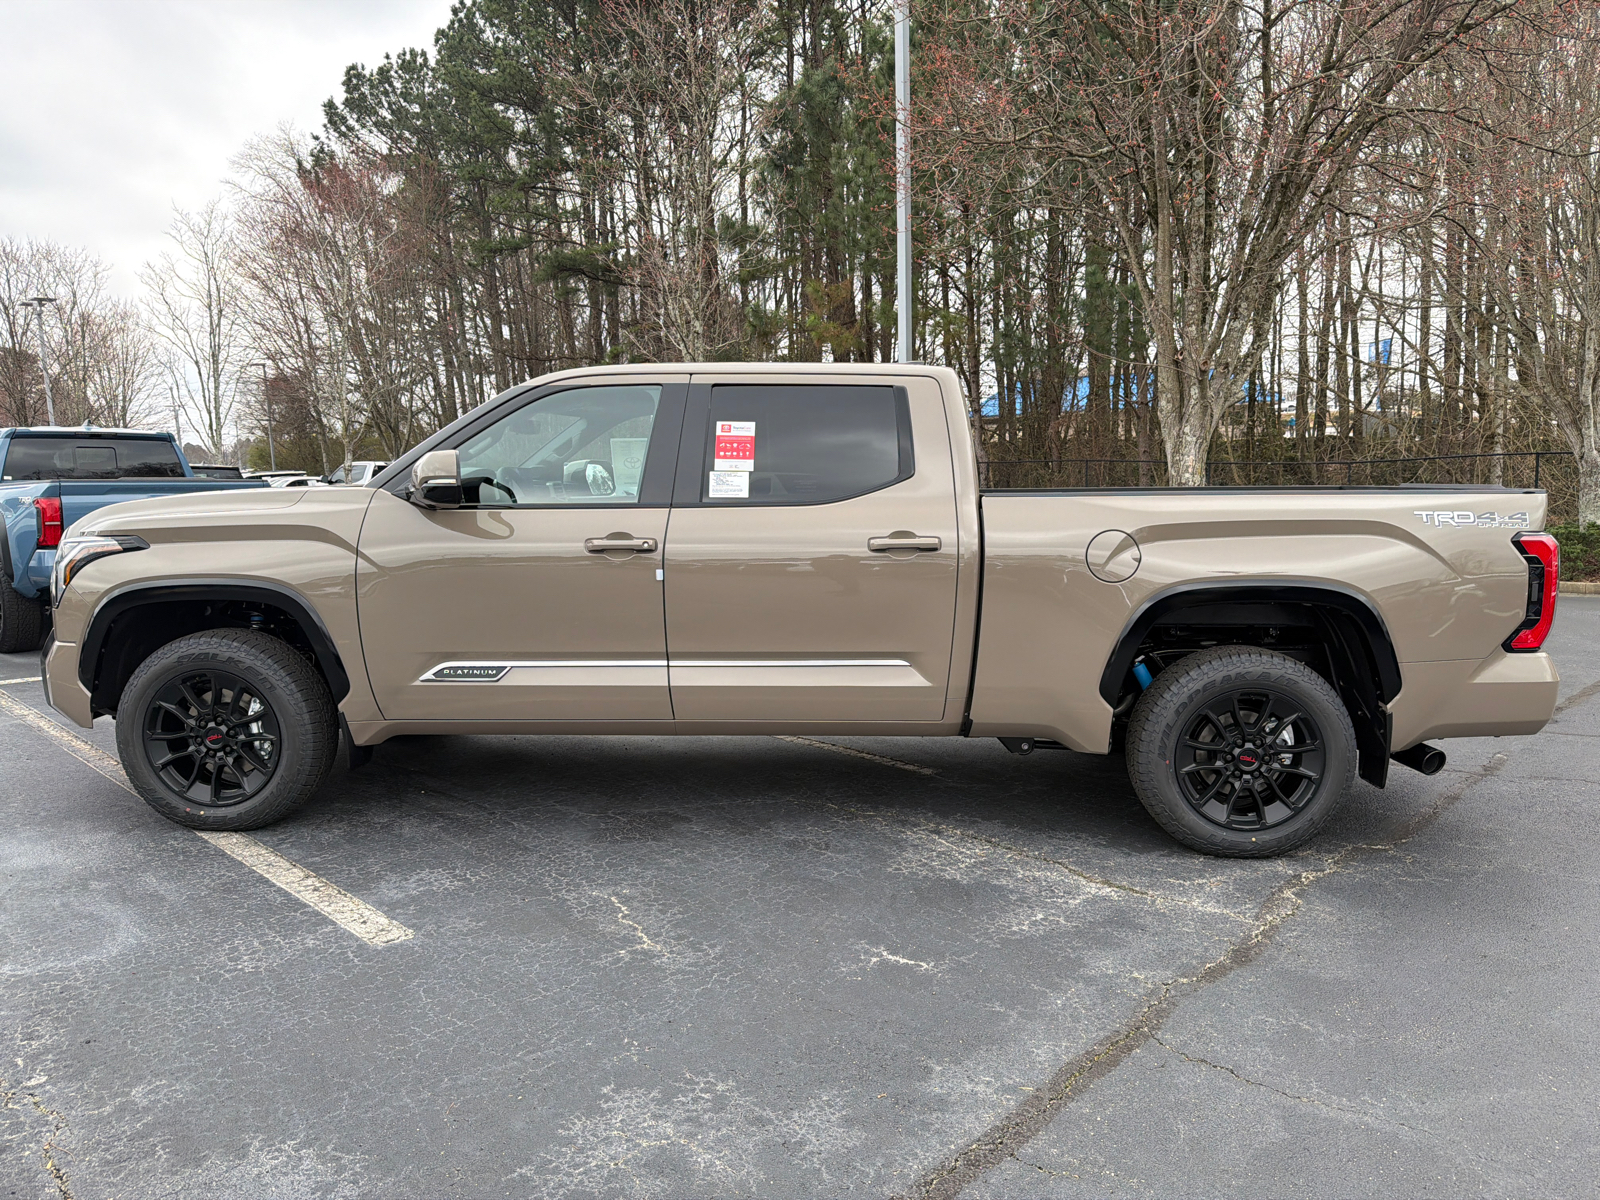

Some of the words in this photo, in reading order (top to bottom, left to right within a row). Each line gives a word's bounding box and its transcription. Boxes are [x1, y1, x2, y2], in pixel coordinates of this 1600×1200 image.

[1413, 511, 1477, 528] TRD
[1157, 672, 1250, 761] WILDPEAK
[206, 734, 223, 742] TRD
[1239, 755, 1256, 763] TRD
